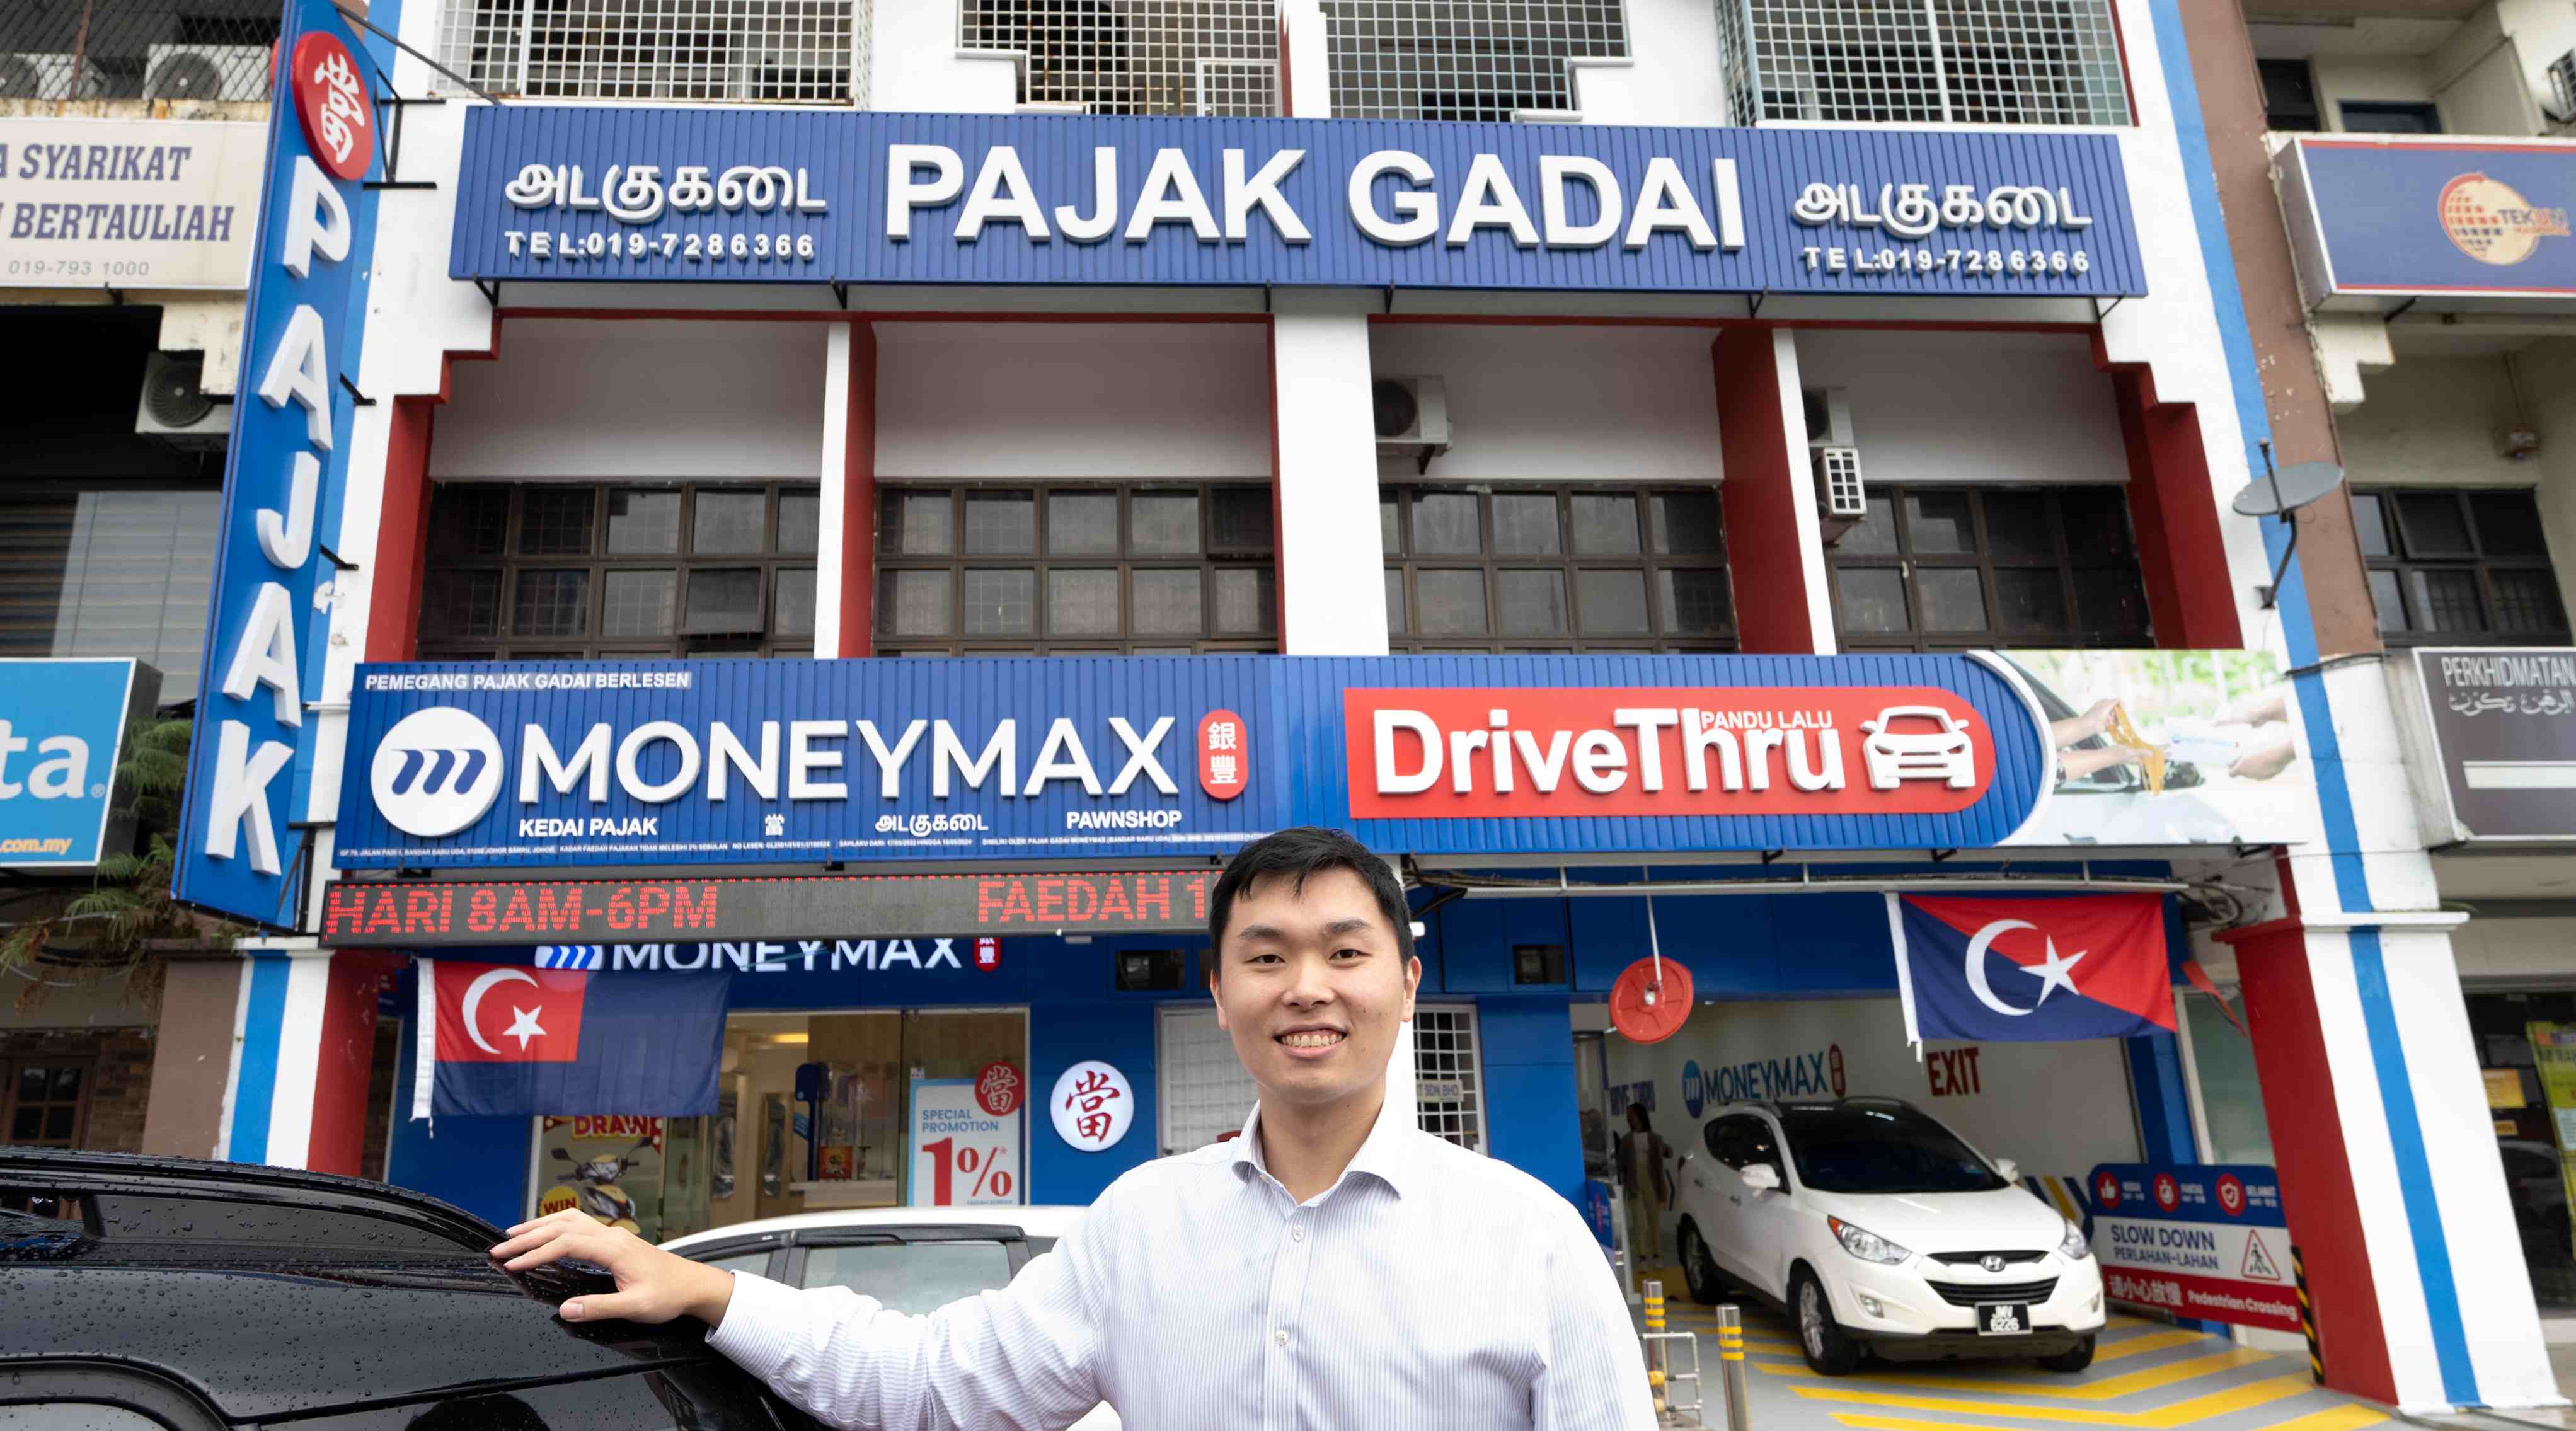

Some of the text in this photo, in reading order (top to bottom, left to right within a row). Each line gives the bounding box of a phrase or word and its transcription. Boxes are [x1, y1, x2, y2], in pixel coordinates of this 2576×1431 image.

[20, 144, 192, 181] SYARIKAT
[887, 144, 1745, 251] PAJAK GADAI
[11, 203, 234, 241] BERTAULIAH
[8, 260, 149, 276] 019-793 1000
[205, 155, 351, 876] PAJAK
[365, 672, 689, 690] PEMEGANG PAJAK GADAI BERLESEN
[2441, 657, 2576, 686] PERKHIDMATAN
[1701, 710, 1832, 729] PANDU LALU
[519, 717, 1179, 805] MONEYMAX
[1208, 721, 1238, 784] 銀豐
[1373, 708, 1846, 795] DriveThru
[519, 817, 658, 837] KEDAI PAJAK
[1067, 810, 1182, 829] PAWNSHOP
[326, 885, 718, 933] HARI 8AM-6PM
[978, 877, 1207, 922] FAEDAH 1
[613, 938, 962, 972] MONEYMAX
[1703, 1051, 1827, 1105] MONEYMAX
[1926, 1047, 1981, 1097] EXIT
[922, 1109, 972, 1120] SPECIAL
[922, 1121, 999, 1133] PROMOTION
[544, 1197, 577, 1215] WIN
[2111, 1224, 2216, 1251] SLOW DOWN
[2114, 1247, 2219, 1270] PERLAHAN-LAHAN
[2188, 1290, 2298, 1322] Pedestrian Crossing
